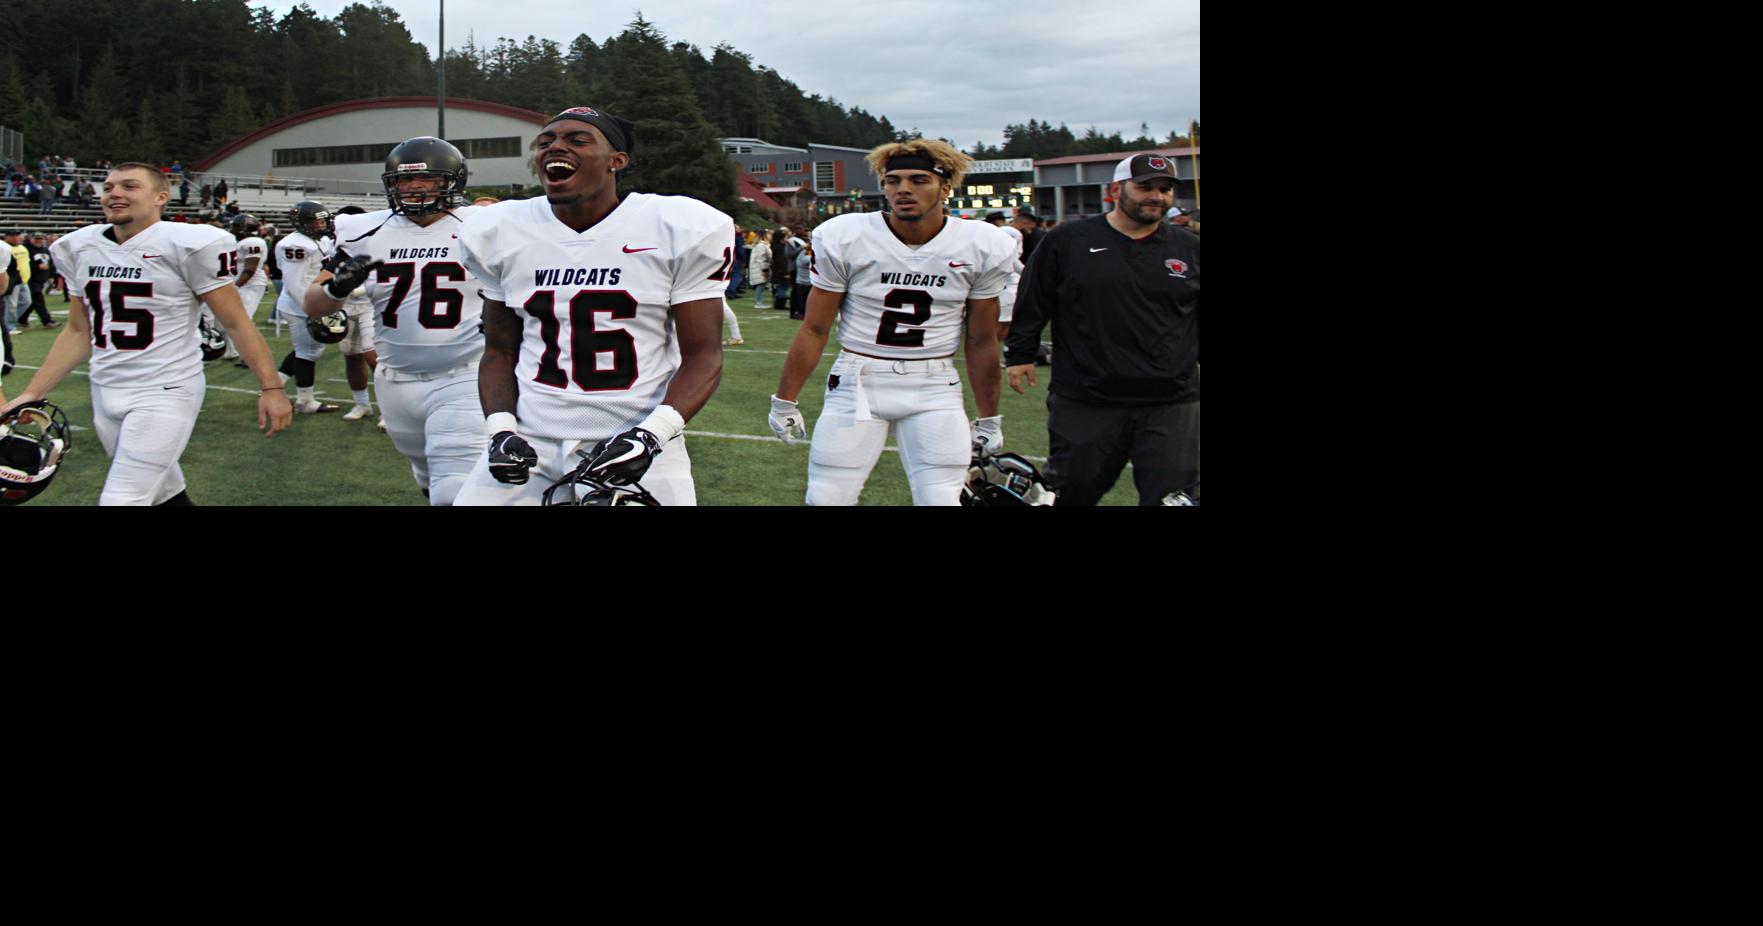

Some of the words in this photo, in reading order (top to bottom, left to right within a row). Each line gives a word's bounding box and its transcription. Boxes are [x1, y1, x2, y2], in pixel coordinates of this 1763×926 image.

[284, 248, 305, 260] 56
[389, 247, 449, 259] WILDCATS
[88, 266, 142, 279] WILDCATS
[535, 268, 621, 286] WILDCATS
[880, 272, 947, 287] WILDCATS
[376, 261, 466, 329] 76
[84, 280, 154, 350] 15
[876, 288, 934, 347] 2
[523, 289, 639, 392] 16
